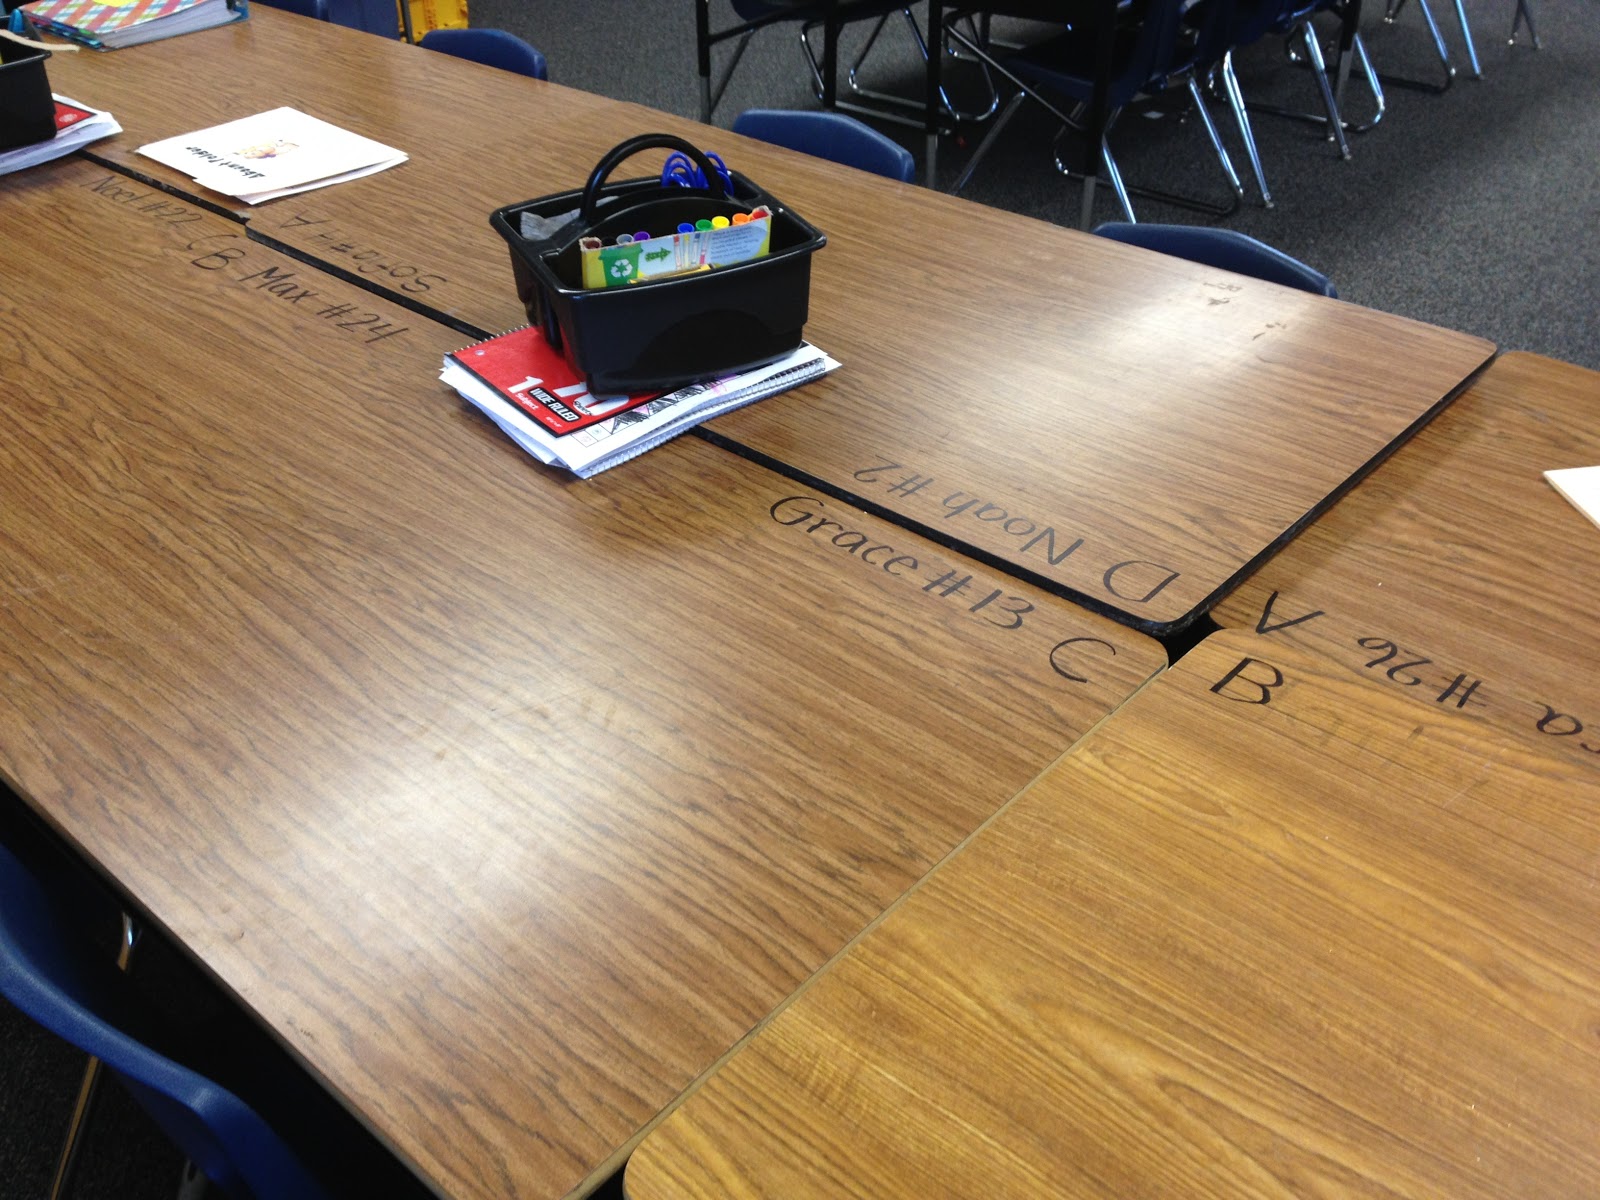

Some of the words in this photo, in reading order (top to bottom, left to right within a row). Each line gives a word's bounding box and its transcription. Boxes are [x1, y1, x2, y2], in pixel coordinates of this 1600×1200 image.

[80, 175, 152, 204] Noel
[138, 200, 203, 228] #22
[279, 210, 333, 229] A
[190, 247, 246, 270] B
[238, 266, 319, 304] Max
[316, 303, 409, 344] #24
[507, 375, 544, 394] 1
[516, 393, 539, 411] Subject
[529, 387, 556, 405] WIDE
[548, 402, 580, 421] RULED
[852, 453, 934, 499] #2
[943, 490, 1084, 566] Noah
[770, 496, 918, 577] Grace
[921, 569, 1035, 630] #13
[1049, 637, 1116, 684] C
[1103, 560, 1181, 603] D
[1256, 590, 1326, 634] A
[1210, 657, 1284, 705] B
[1357, 637, 1487, 708] #26
